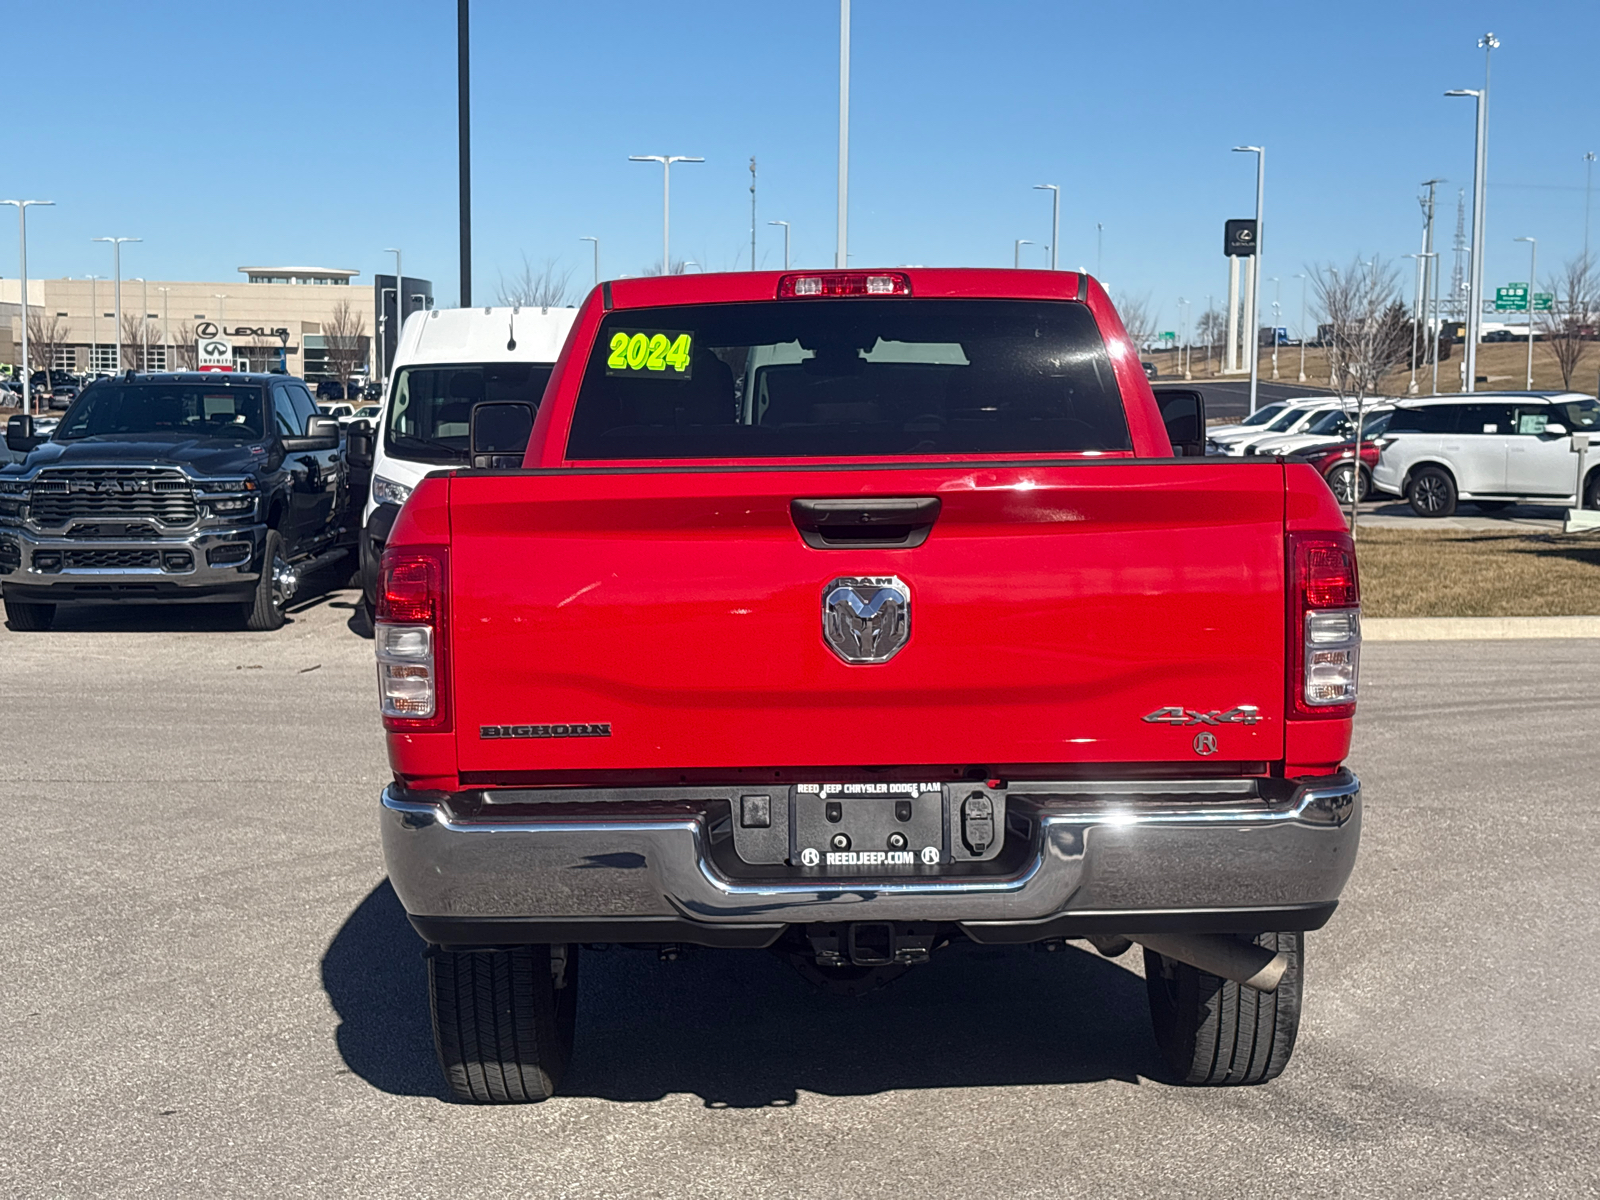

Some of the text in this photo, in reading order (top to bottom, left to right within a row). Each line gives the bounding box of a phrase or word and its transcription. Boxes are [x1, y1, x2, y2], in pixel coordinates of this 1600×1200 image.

[223, 326, 288, 337] LEXUS
[607, 332, 692, 372] 2024
[70, 481, 150, 492] RAM
[838, 577, 893, 587] RAM
[1140, 705, 1263, 725] 4x4
[480, 723, 611, 739] BIGHORN
[797, 782, 941, 794] REED JEEP CHRYSLER DODGE RAM
[826, 851, 914, 865] REEDJEEP.COM
